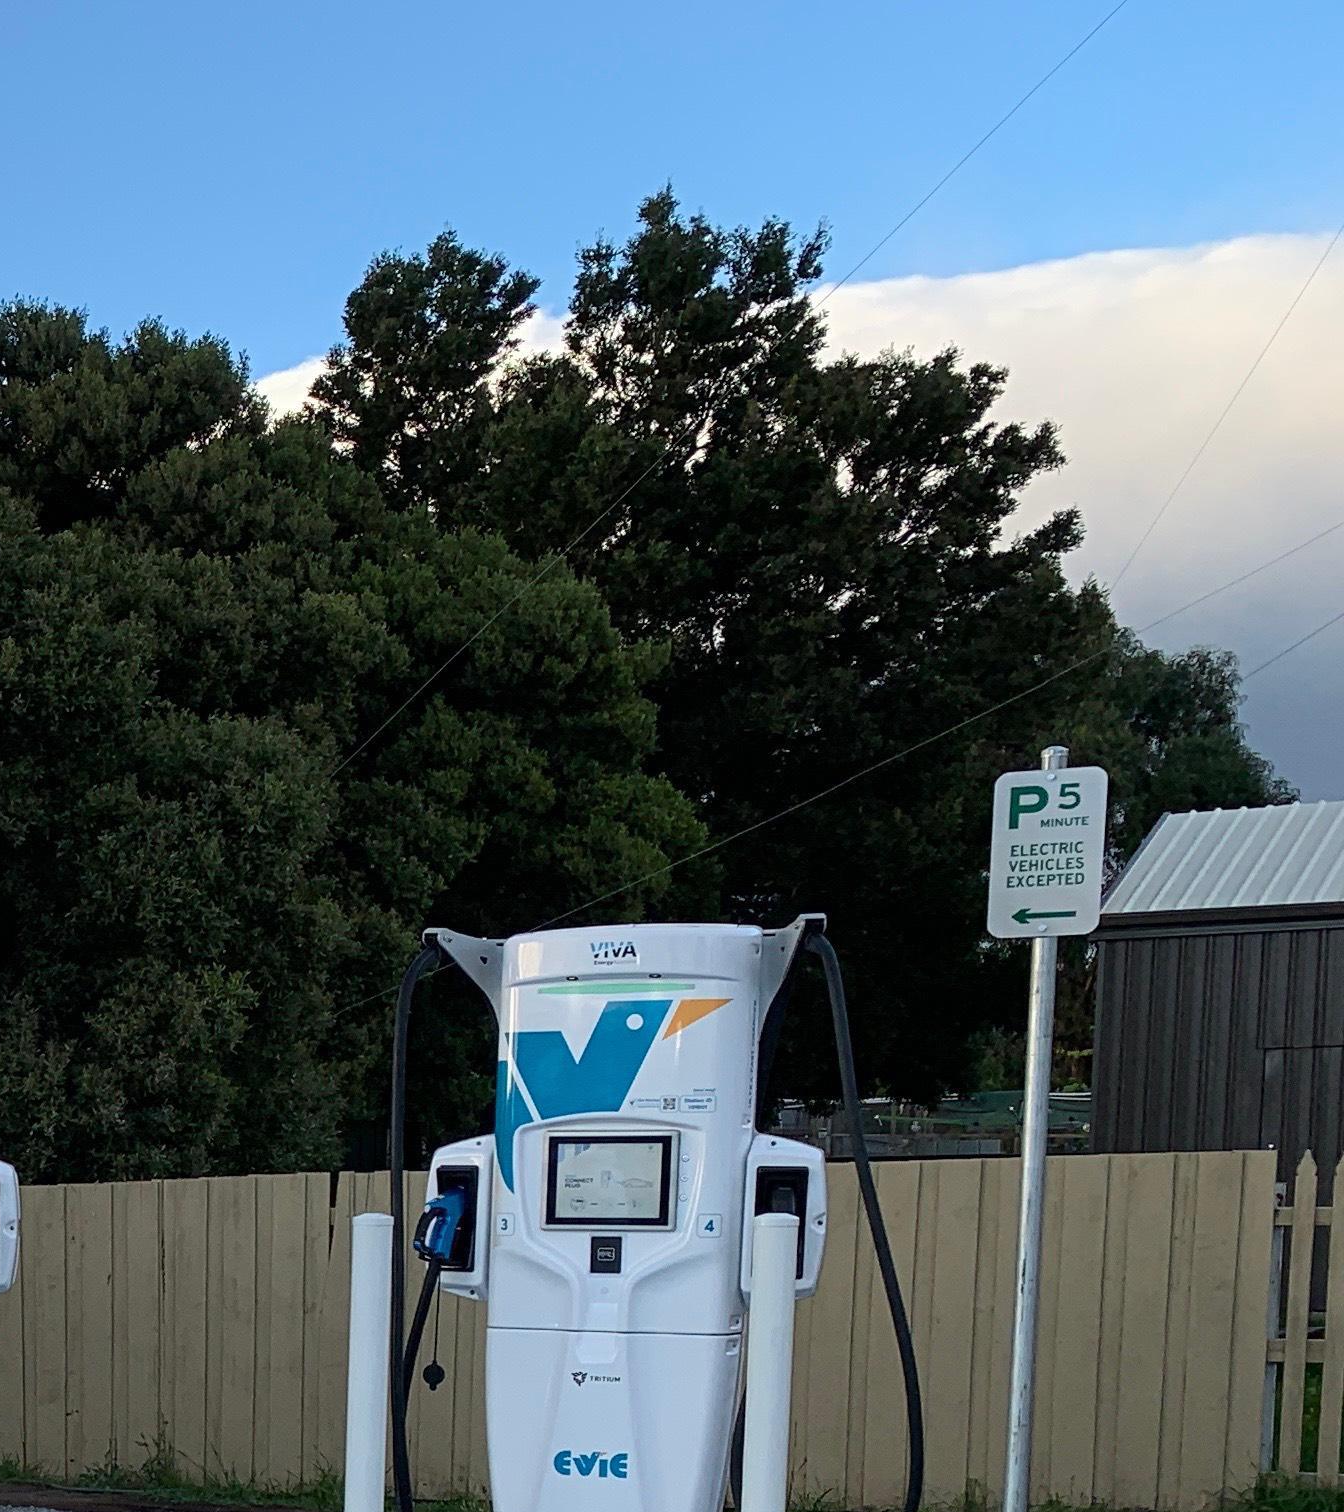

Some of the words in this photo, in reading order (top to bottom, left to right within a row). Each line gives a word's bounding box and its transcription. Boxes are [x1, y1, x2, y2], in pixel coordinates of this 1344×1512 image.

[1008, 785, 1049, 830] P
[1058, 783, 1081, 809] 5
[1040, 816, 1090, 828] MINUTE
[1011, 841, 1084, 857] ELECTRIC
[1008, 857, 1085, 873] VEHICLES
[1006, 873, 1085, 889] EXCEPTED
[590, 941, 637, 959] VIVA
[500, 1218, 509, 1231] 3
[704, 1219, 715, 1233] 4
[589, 1375, 621, 1383] TRITIUM
